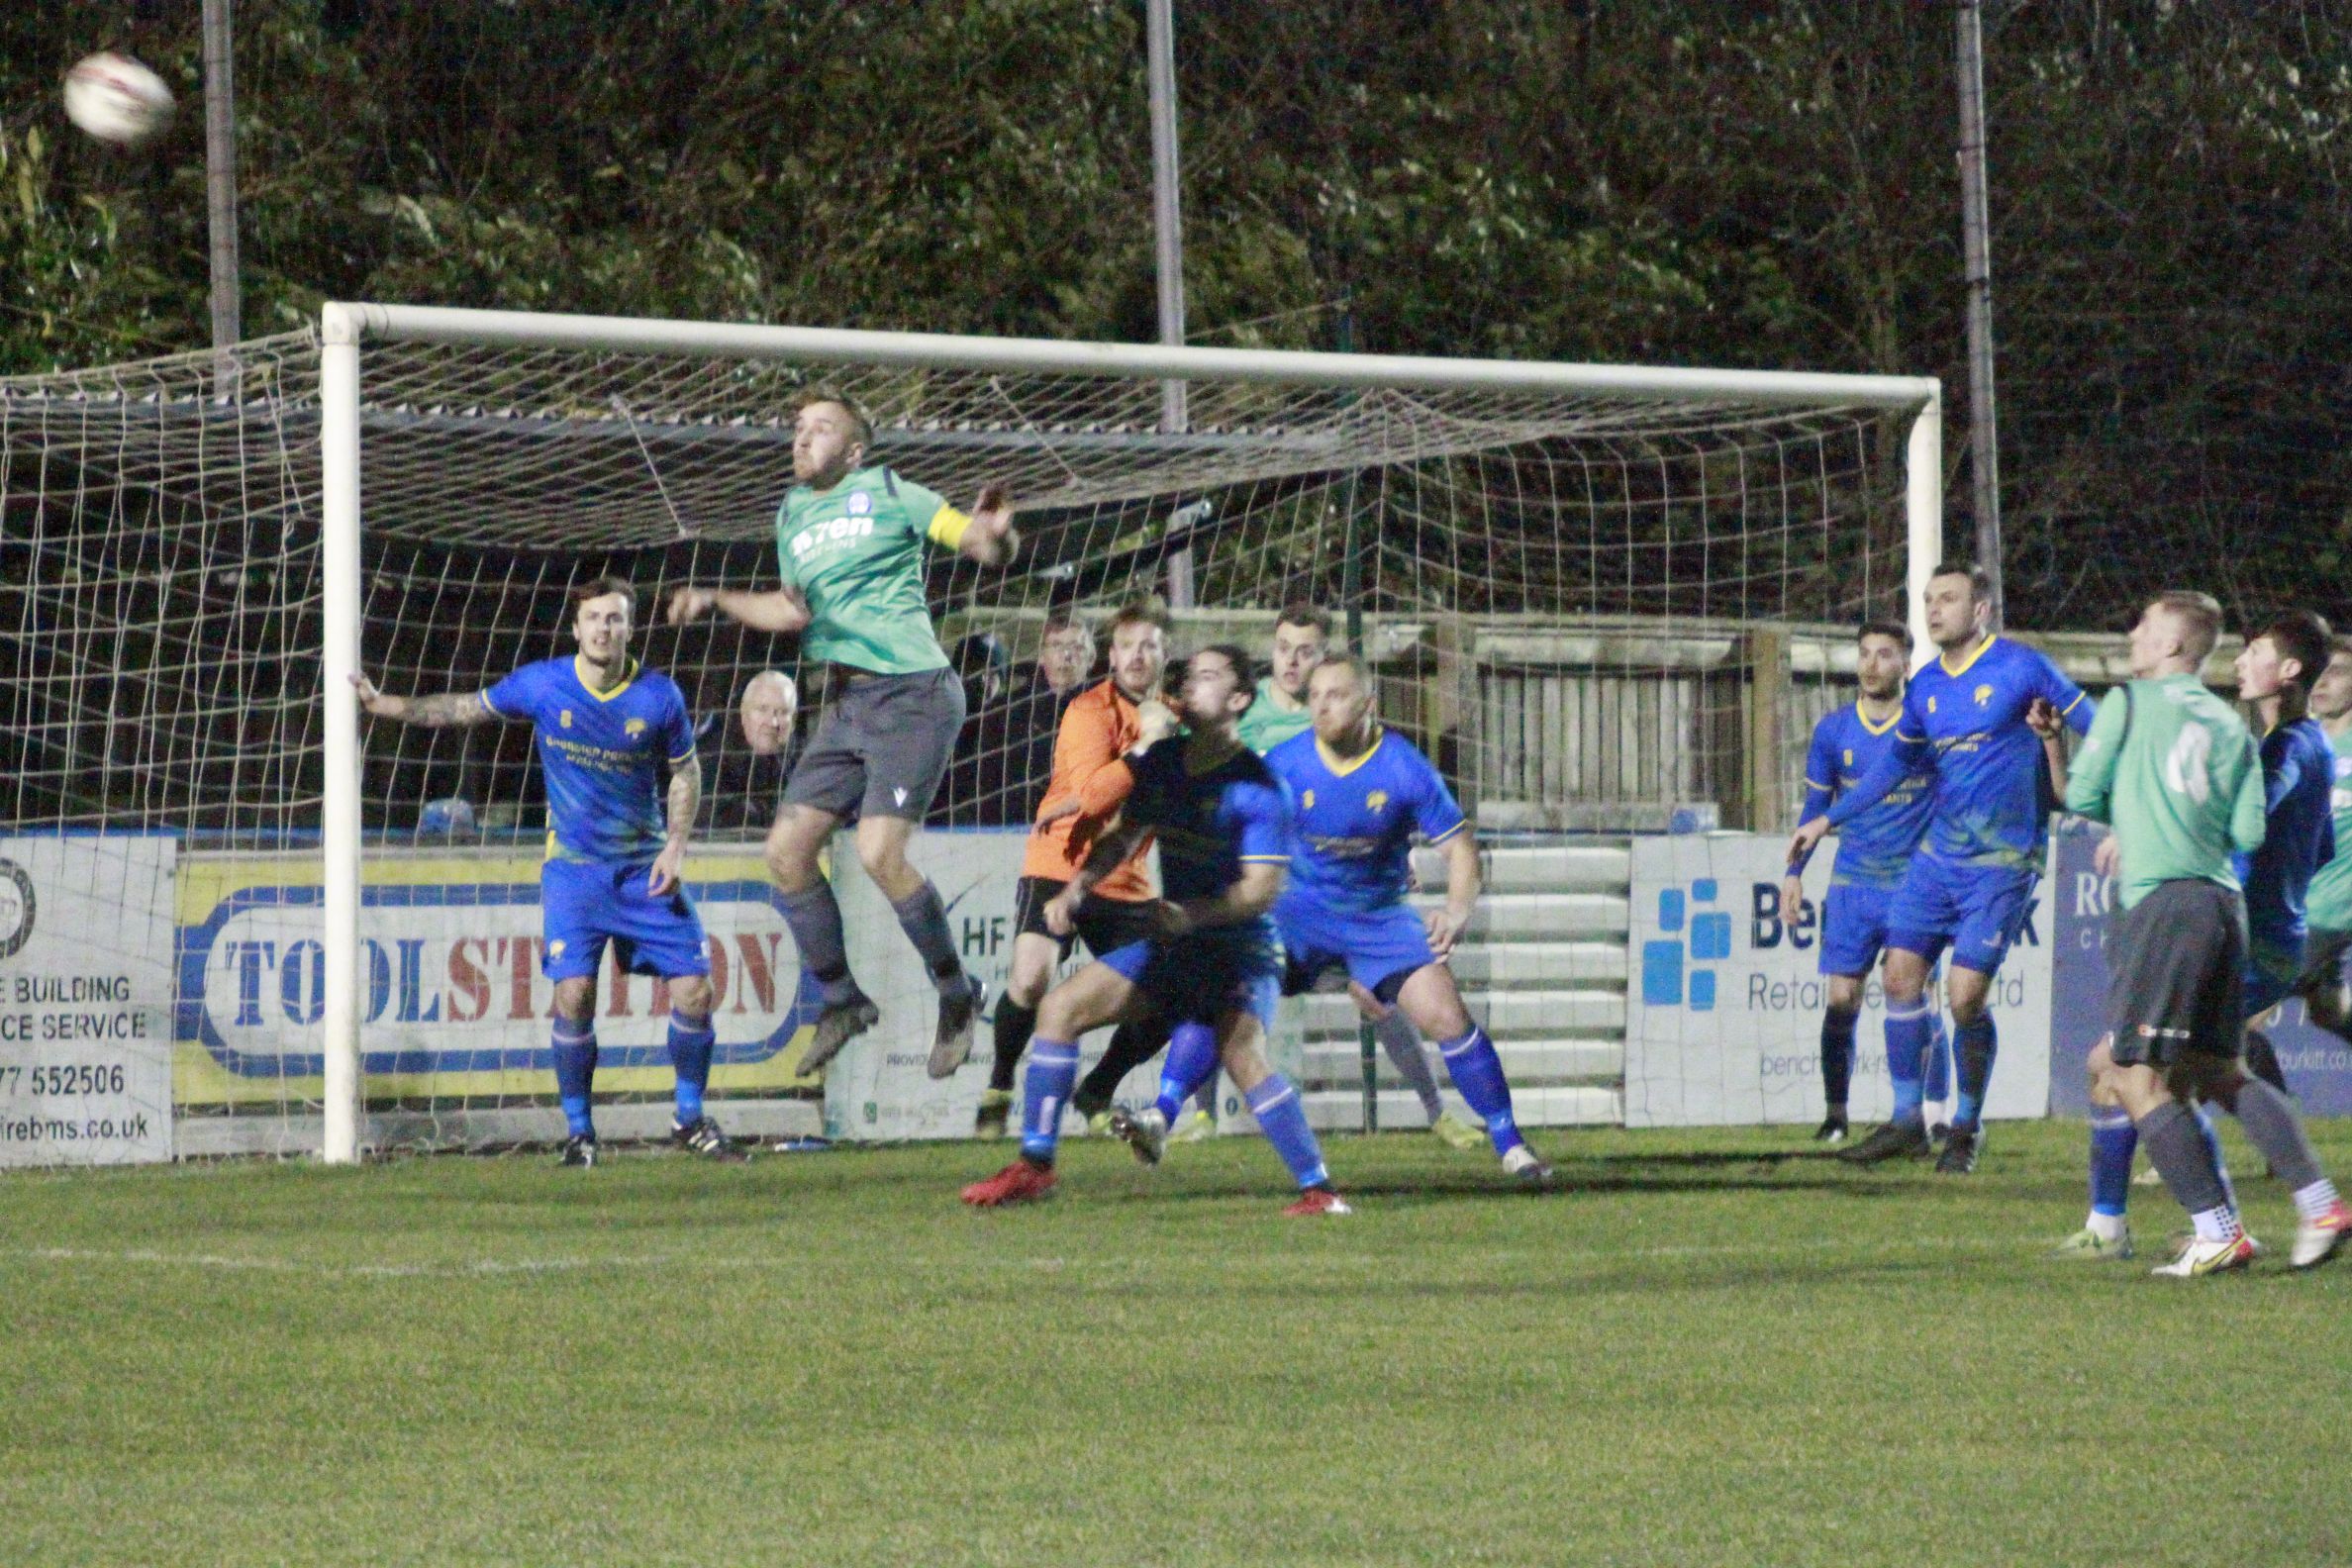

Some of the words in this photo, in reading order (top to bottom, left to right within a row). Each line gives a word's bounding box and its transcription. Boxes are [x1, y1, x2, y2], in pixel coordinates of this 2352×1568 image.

[16, 976, 131, 1003] BUILDING
[225, 932, 783, 1027] TOOLSTTN
[1748, 973, 1826, 1010] Retai
[1991, 969, 2024, 1008] td
[43, 1012, 147, 1039] SERVICE
[32, 1064, 125, 1096] 552506
